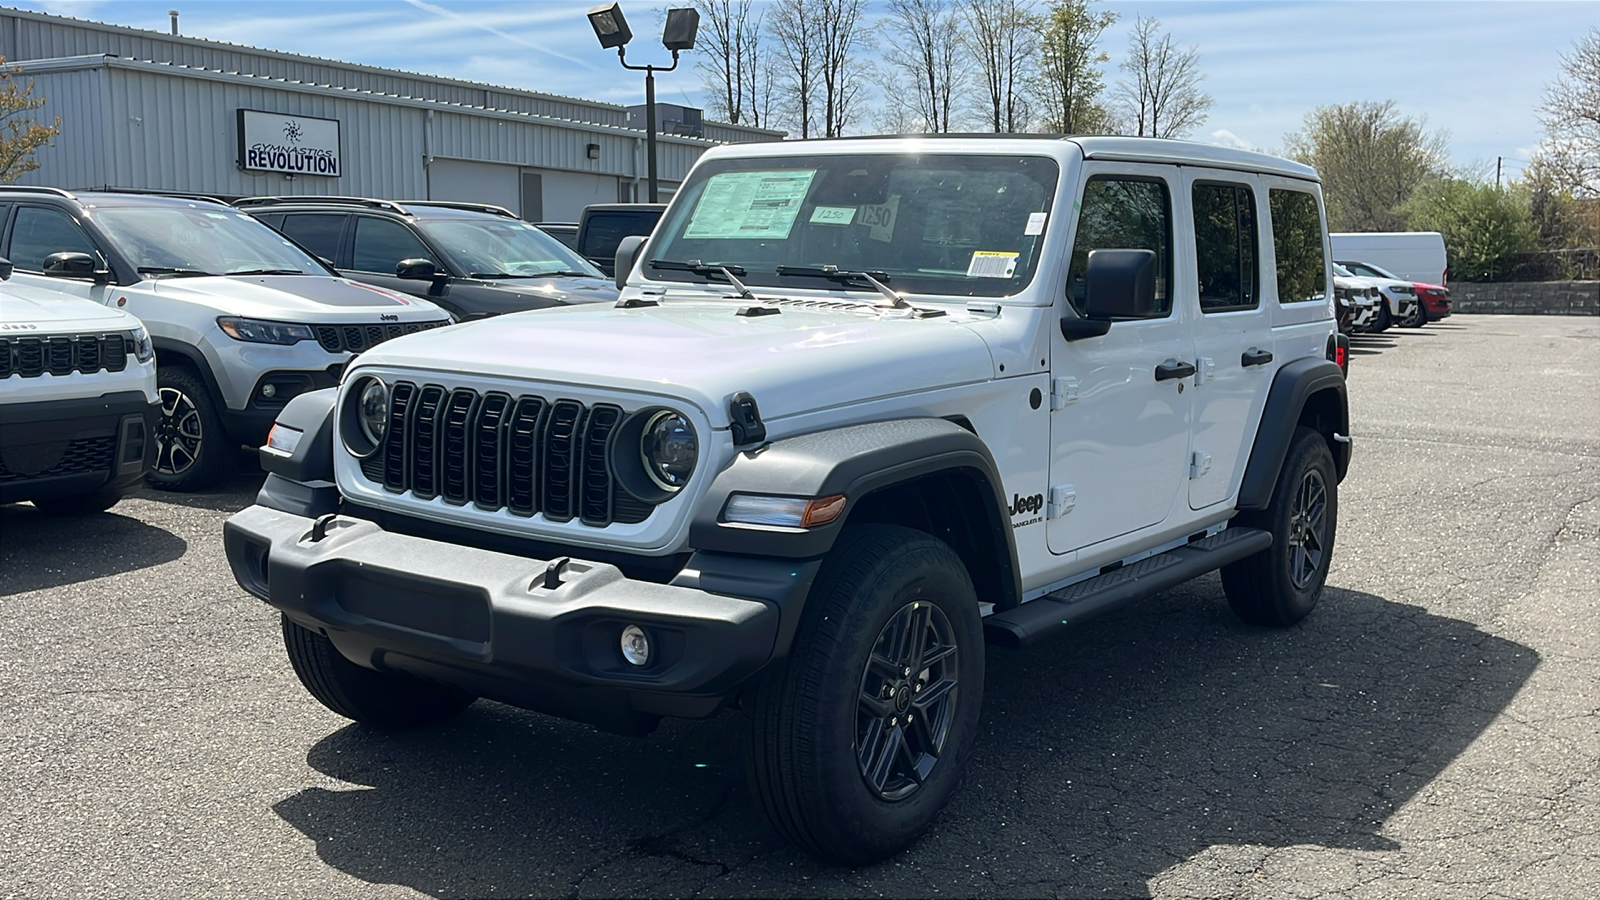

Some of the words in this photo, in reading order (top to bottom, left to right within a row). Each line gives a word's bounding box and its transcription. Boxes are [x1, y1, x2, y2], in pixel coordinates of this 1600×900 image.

[252, 143, 333, 158] GYMNASTICS
[248, 149, 337, 173] REVOLUTION
[817, 209, 844, 219] 1250
[861, 202, 892, 228] 1250
[380, 313, 399, 321] Jeep
[1008, 493, 1043, 516] Jeep
